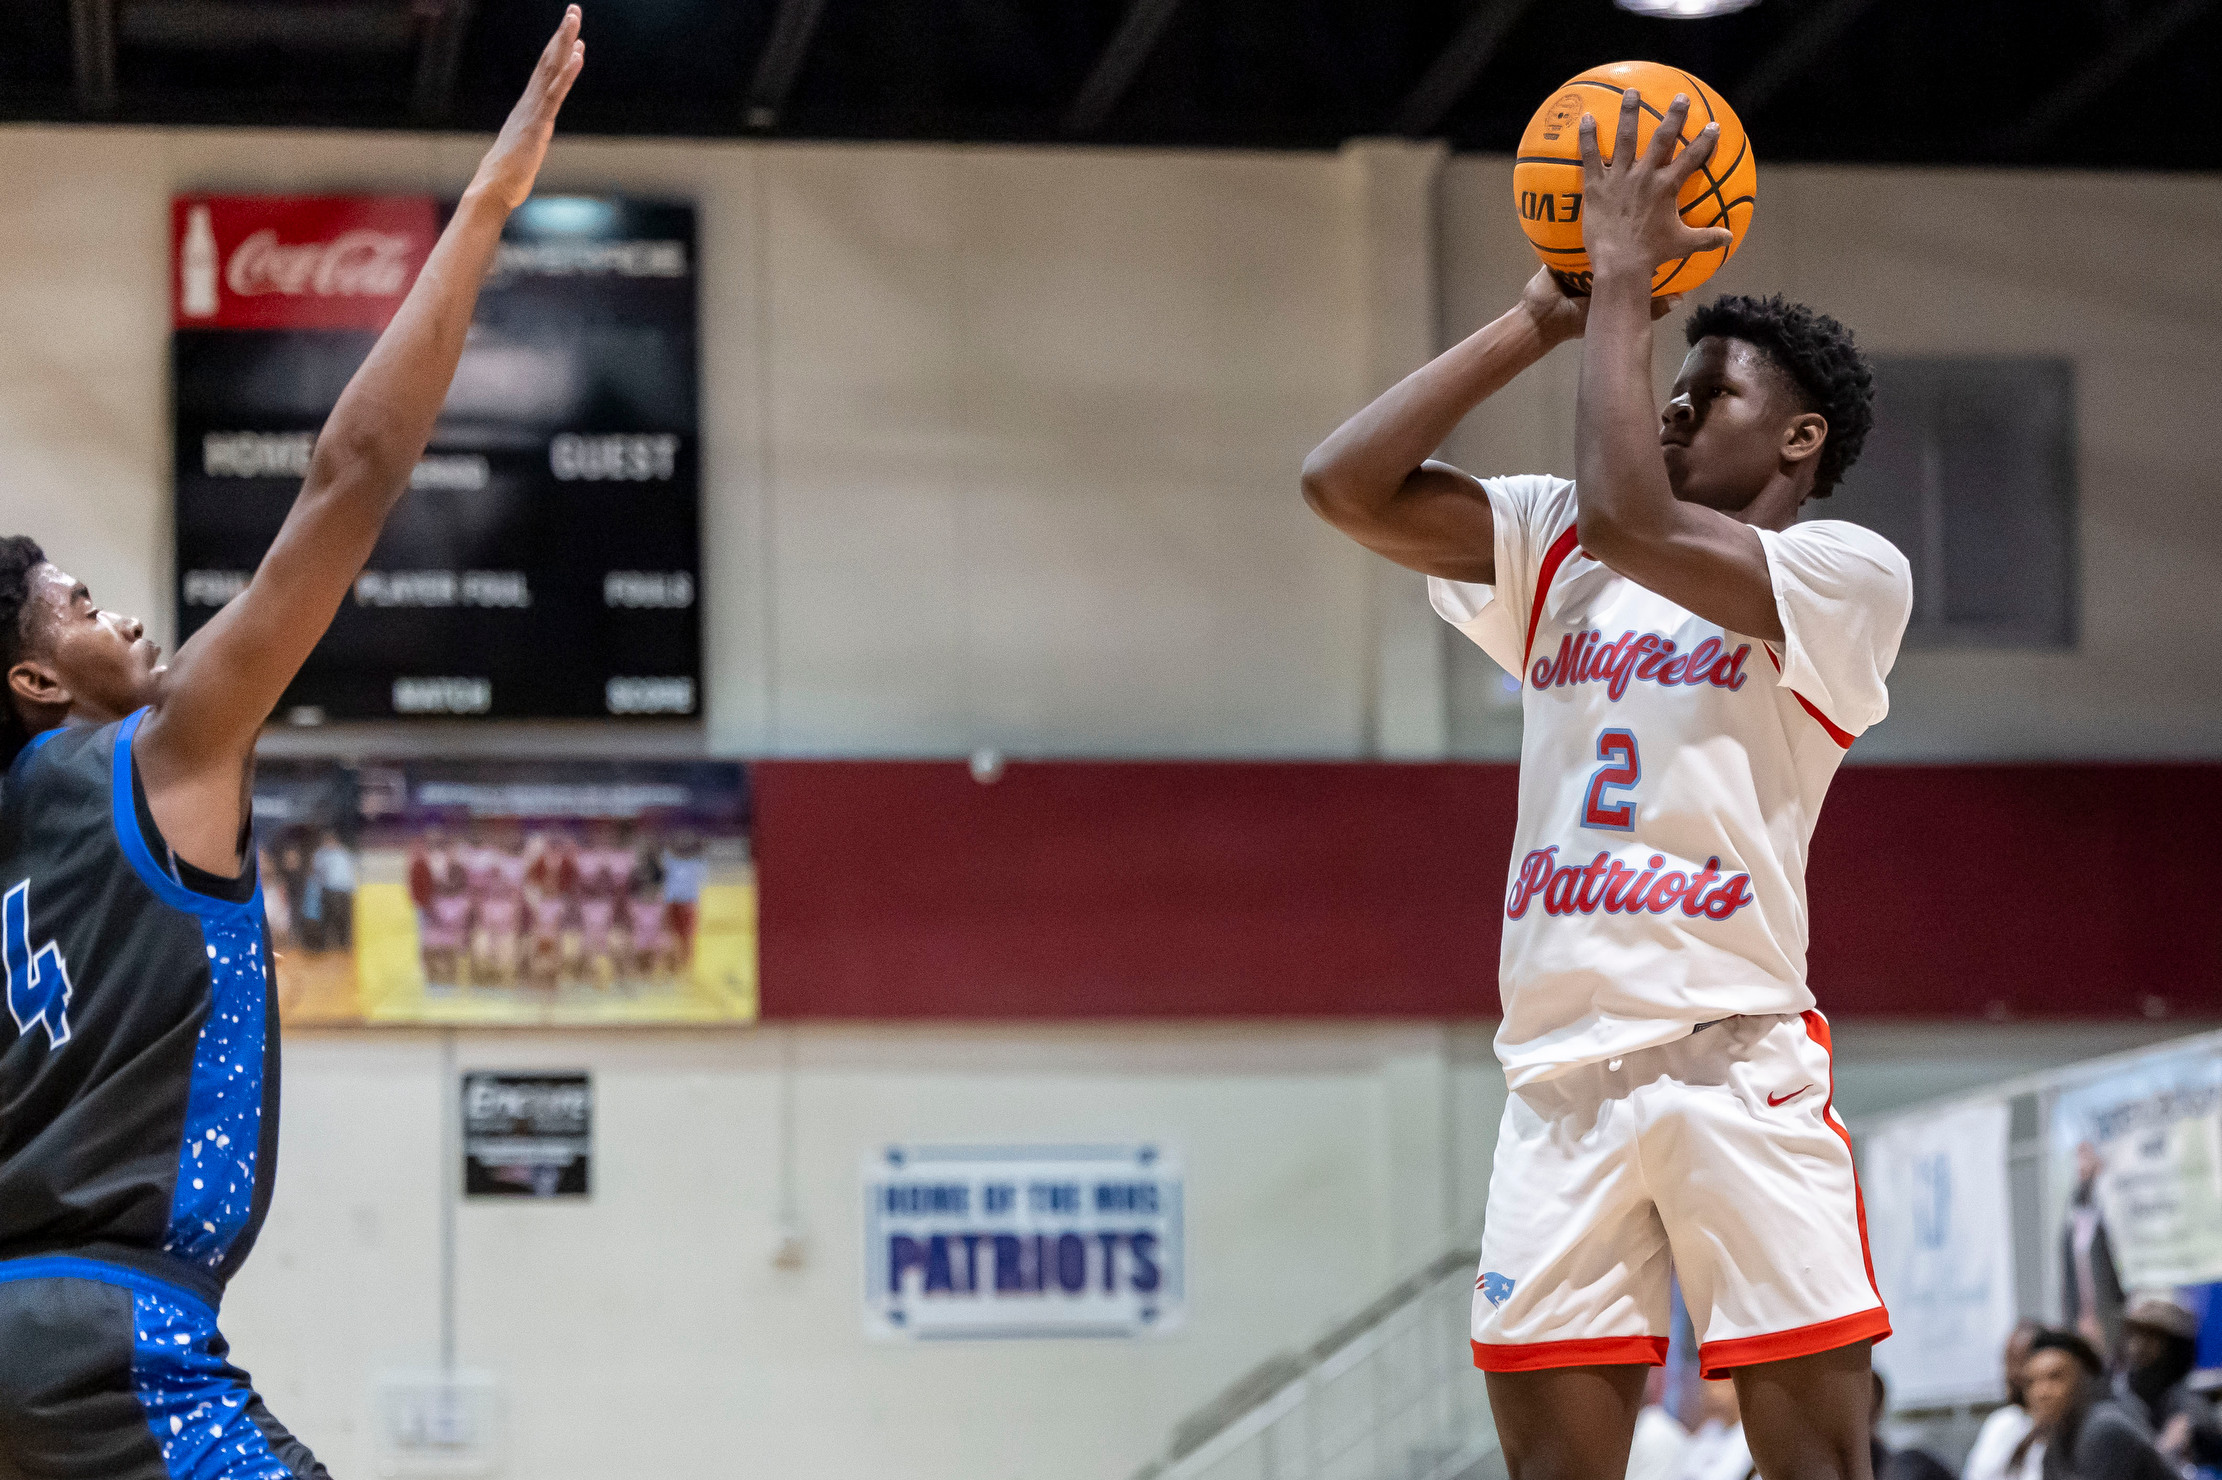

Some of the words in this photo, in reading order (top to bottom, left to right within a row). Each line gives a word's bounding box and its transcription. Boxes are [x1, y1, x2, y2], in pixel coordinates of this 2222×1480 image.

[1521, 190, 1583, 223] EVO
[550, 434, 679, 480] GUEST
[1531, 630, 1752, 702] Midfield
[1580, 727, 1642, 833] 2
[1506, 845, 1754, 921] Patriots
[2, 877, 73, 1051] 4
[985, 1183, 1017, 1214] OF
[1027, 1183, 1081, 1213] THE
[888, 1233, 1160, 1295] PATRIOTS
